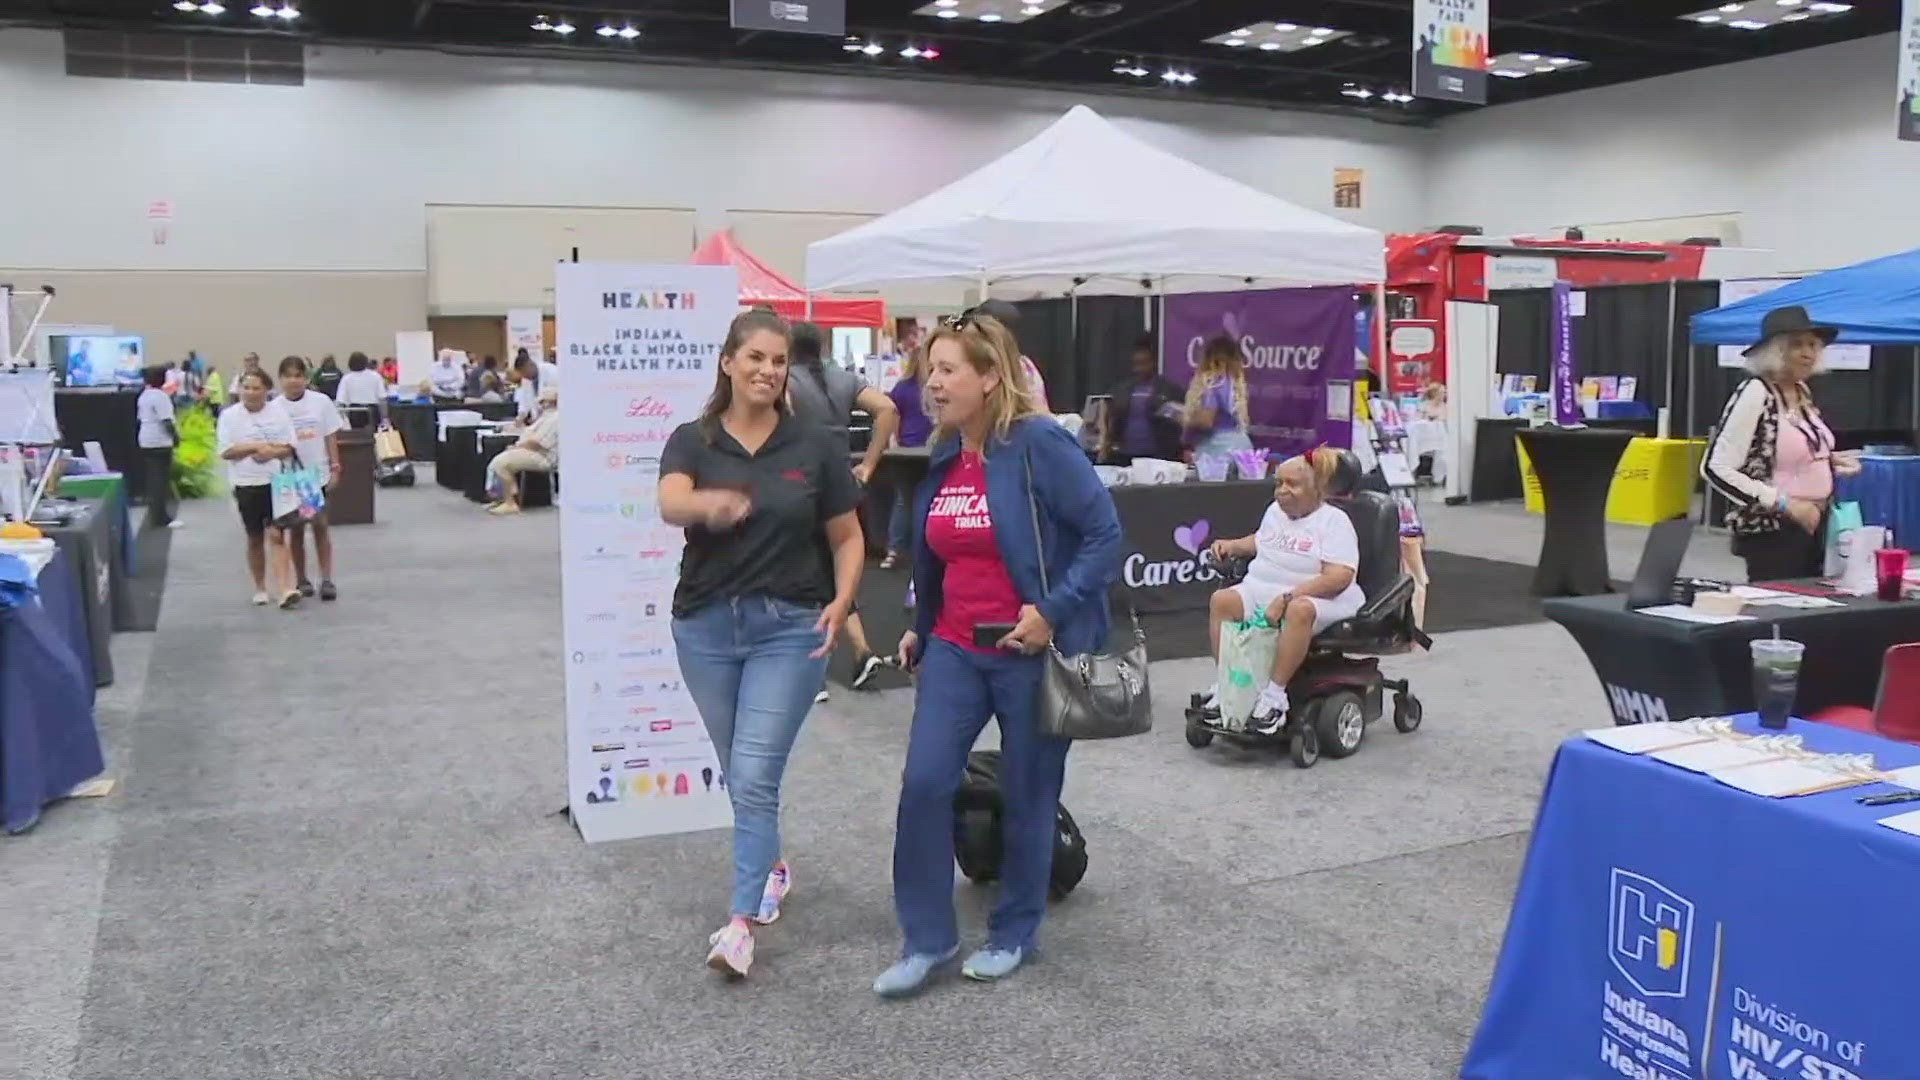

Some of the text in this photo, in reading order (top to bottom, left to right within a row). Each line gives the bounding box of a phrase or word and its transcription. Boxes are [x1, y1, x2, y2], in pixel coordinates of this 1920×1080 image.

[603, 292, 696, 309] HEALTH
[615, 328, 682, 340] INDIANA
[570, 343, 623, 355] BLACK
[1187, 335, 1321, 370] CSource
[597, 358, 703, 370] HEALTH FAIR
[929, 494, 988, 516] CLINICA
[955, 515, 991, 528] TRIALS
[1604, 981, 1689, 1051] Indiana
[1734, 986, 1865, 1066] Division of
[1603, 1005, 1691, 1068] Department
